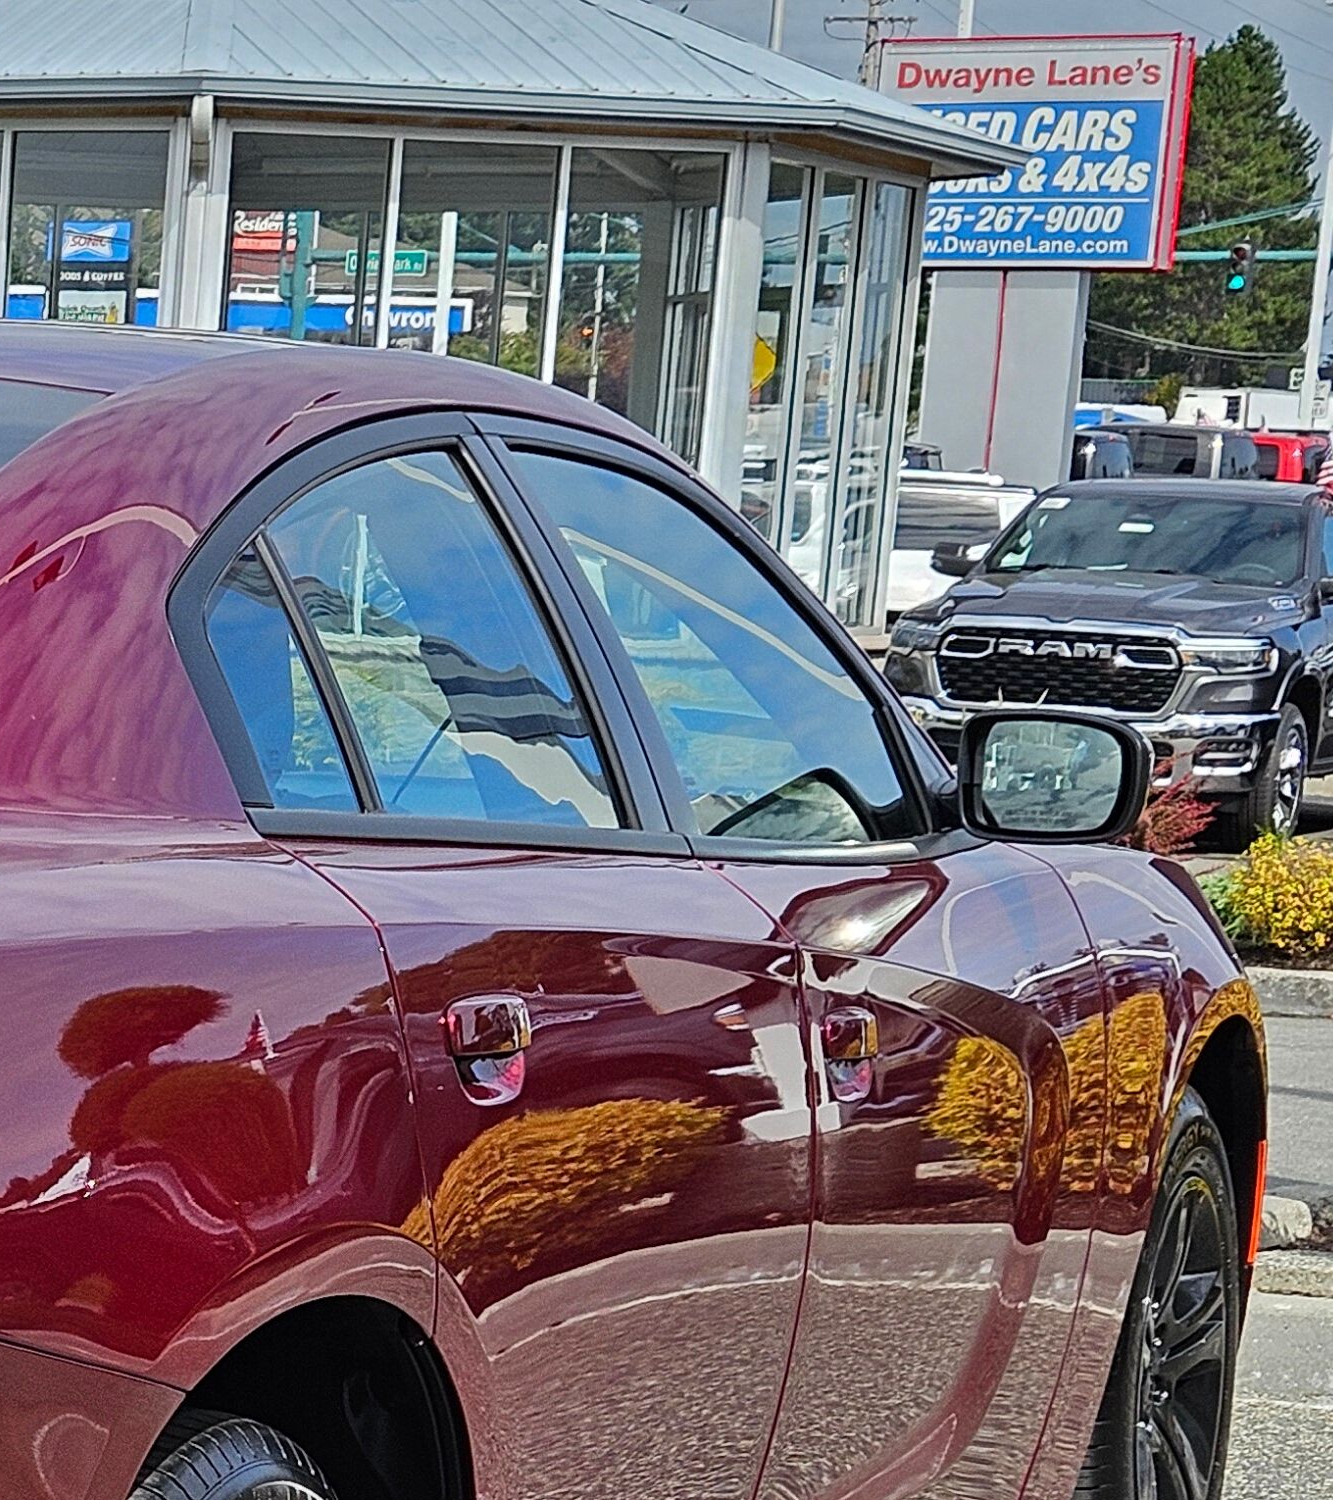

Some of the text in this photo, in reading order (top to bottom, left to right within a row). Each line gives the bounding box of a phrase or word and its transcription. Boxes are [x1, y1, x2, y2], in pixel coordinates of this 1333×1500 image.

[897, 58, 1162, 93] Dwayne Lane's
[1021, 106, 1137, 152] CARS
[1018, 157, 1048, 193] &
[1052, 154, 1152, 193] 4x4s
[925, 204, 1125, 233] 25-267-9000
[923, 235, 1128, 257] w.DwayneLane.com
[345, 305, 436, 329] Chvron
[997, 637, 1113, 659] RAM
